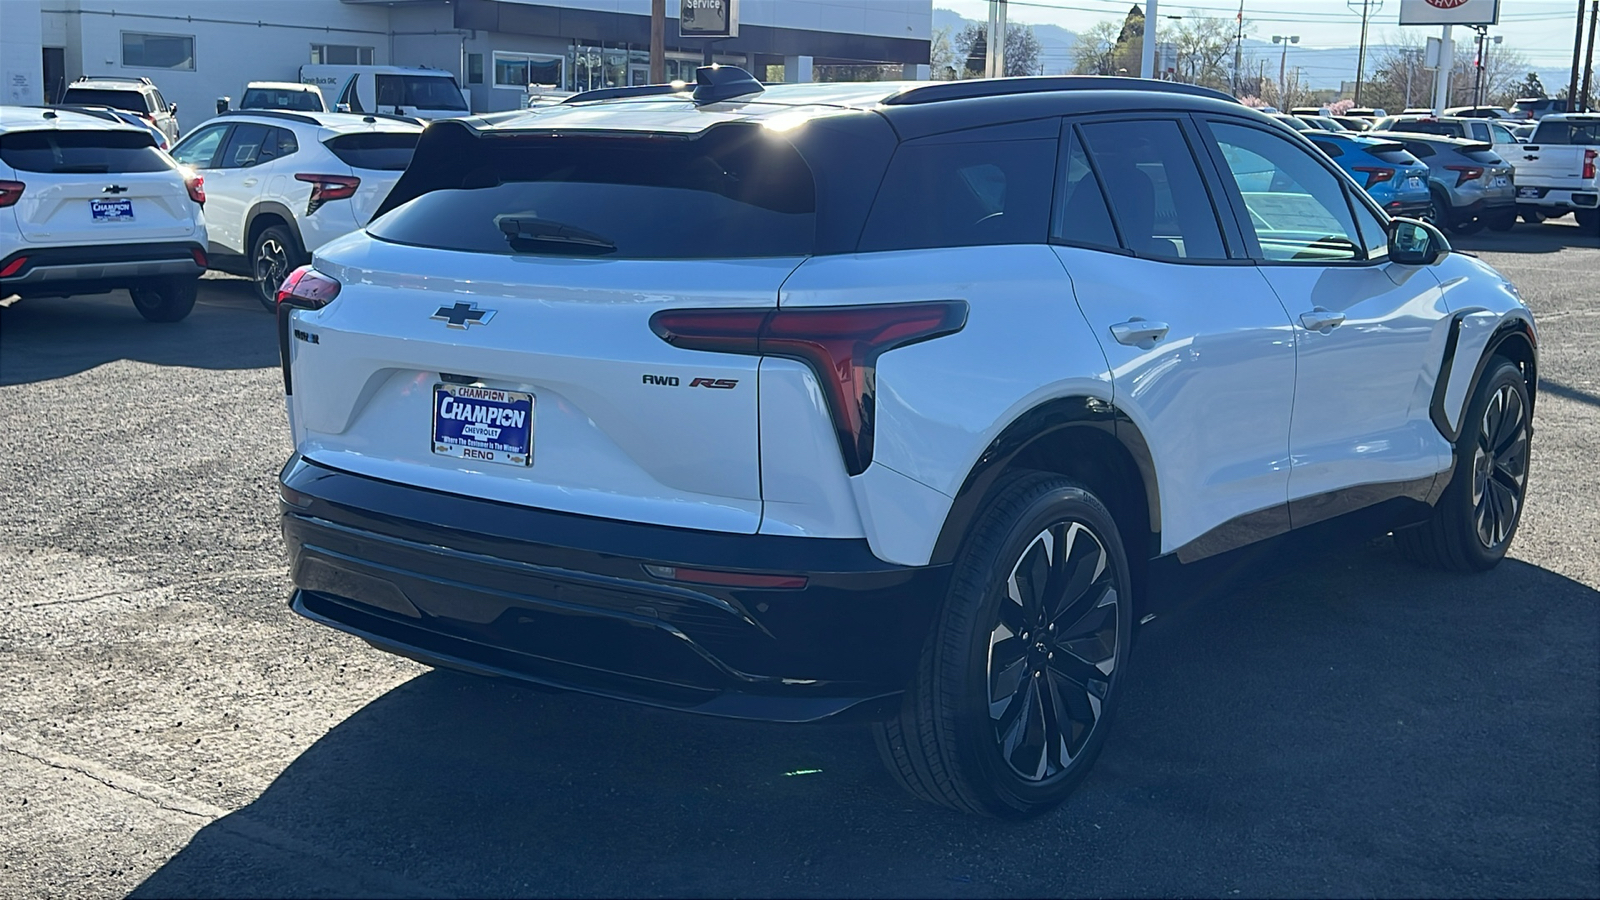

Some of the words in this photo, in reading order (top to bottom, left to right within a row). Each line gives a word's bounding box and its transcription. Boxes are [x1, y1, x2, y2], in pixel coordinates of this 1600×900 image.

[687, 0, 721, 9] Service
[642, 374, 680, 387] AWD
[688, 377, 739, 389] RS
[458, 387, 505, 401] CHAMPION
[440, 396, 526, 429] CHAMPION
[464, 426, 499, 437] CHEVROLET
[463, 448, 495, 461] RENO
